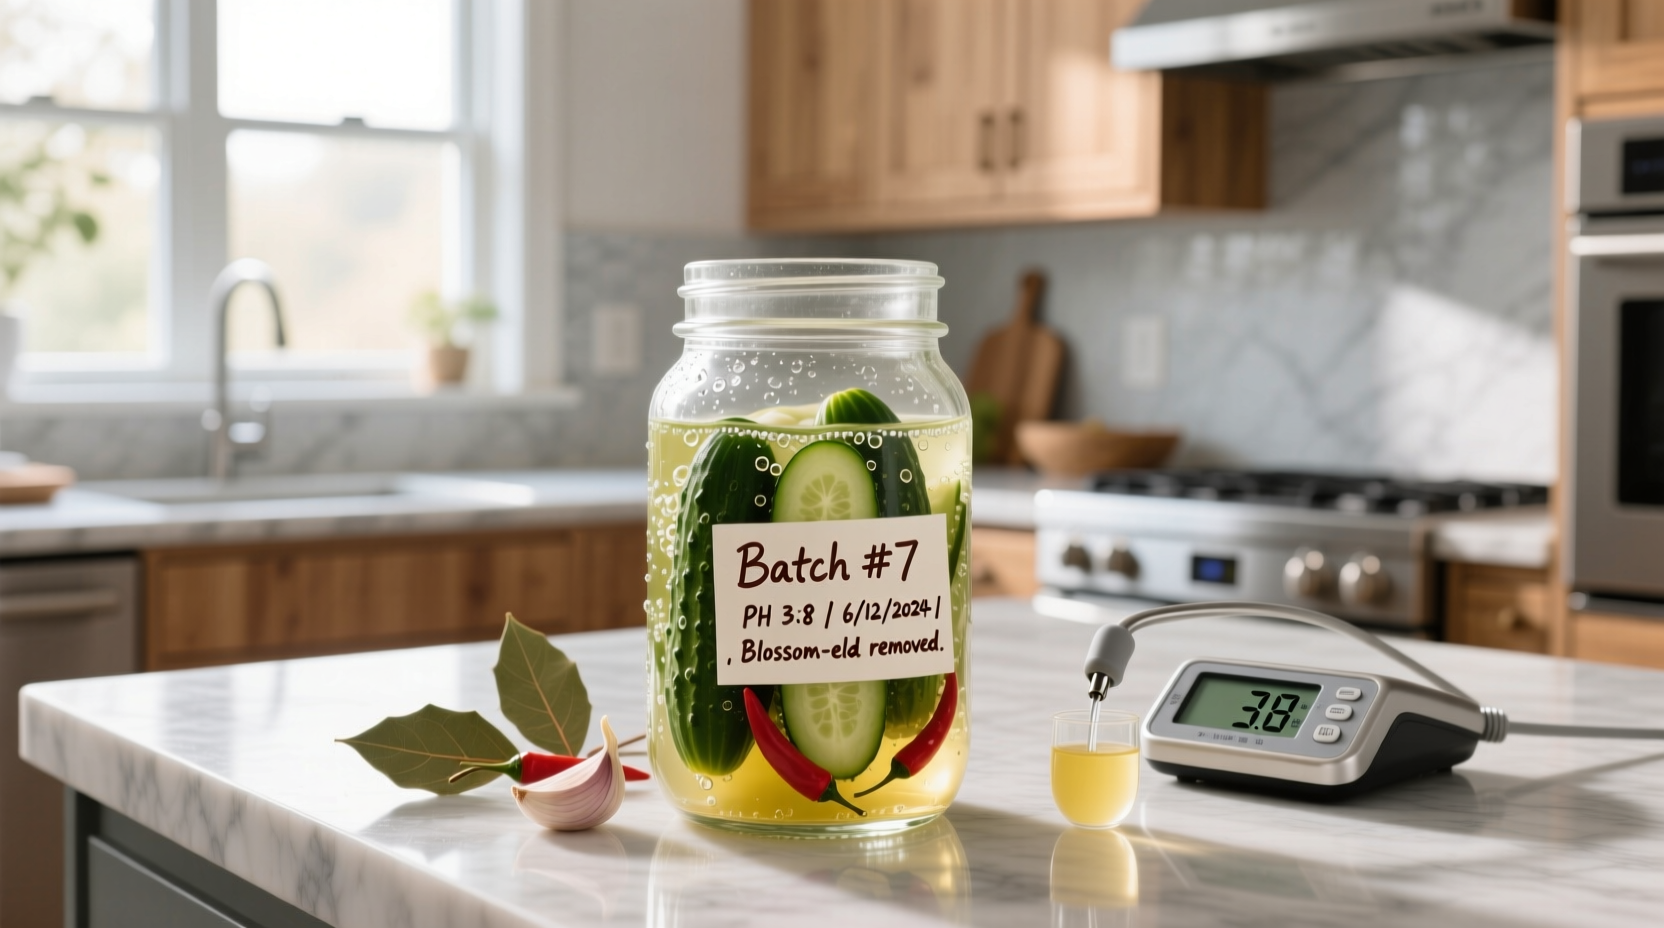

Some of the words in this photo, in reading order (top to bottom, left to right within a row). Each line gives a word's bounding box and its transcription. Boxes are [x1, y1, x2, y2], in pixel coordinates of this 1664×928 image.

[736, 541, 850, 588] Batch
[861, 539, 919, 581] #7
[742, 604, 772, 629] PH
[869, 629, 944, 657] removed.
[1231, 690, 1300, 733] 3.8
